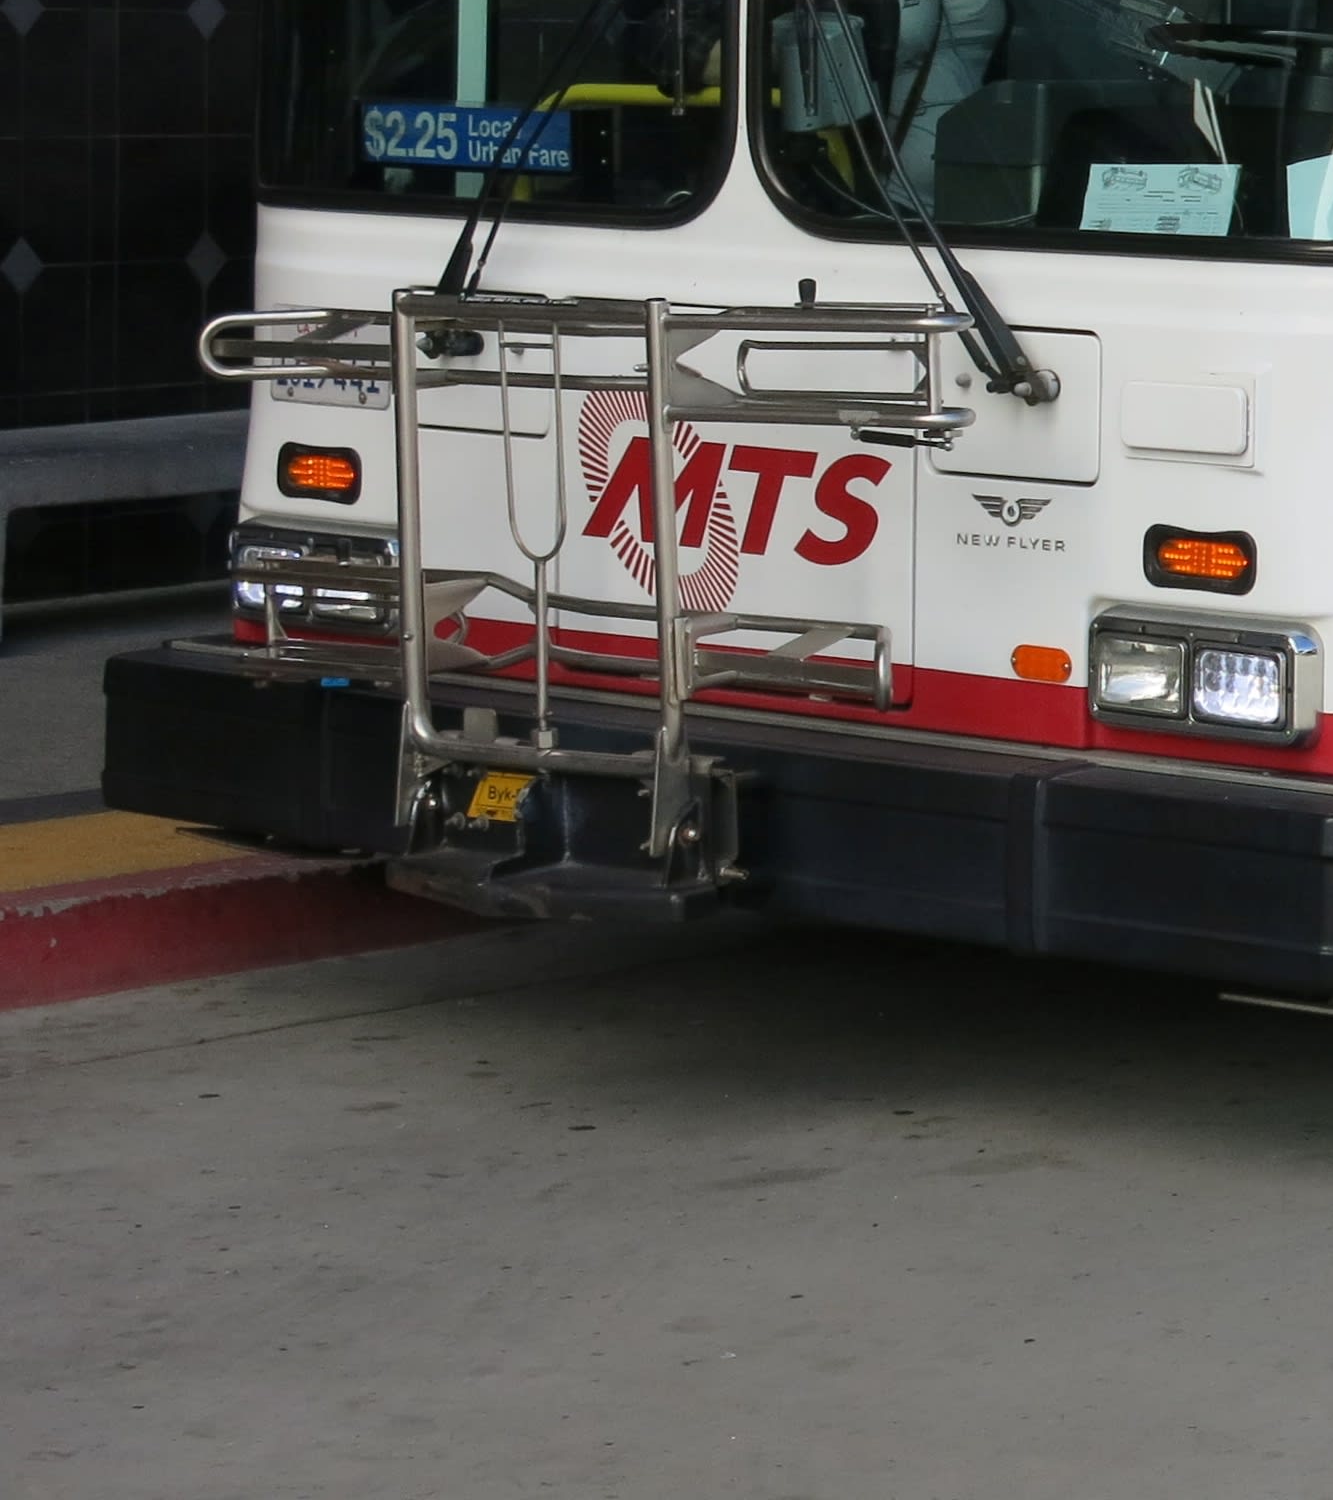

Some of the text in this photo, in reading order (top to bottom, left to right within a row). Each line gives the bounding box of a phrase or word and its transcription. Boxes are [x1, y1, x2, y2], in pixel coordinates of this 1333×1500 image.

[364, 106, 459, 161] $2.25
[528, 143, 570, 167] Fare
[581, 435, 893, 567] MTS
[956, 532, 1066, 552] NEW FLYER
